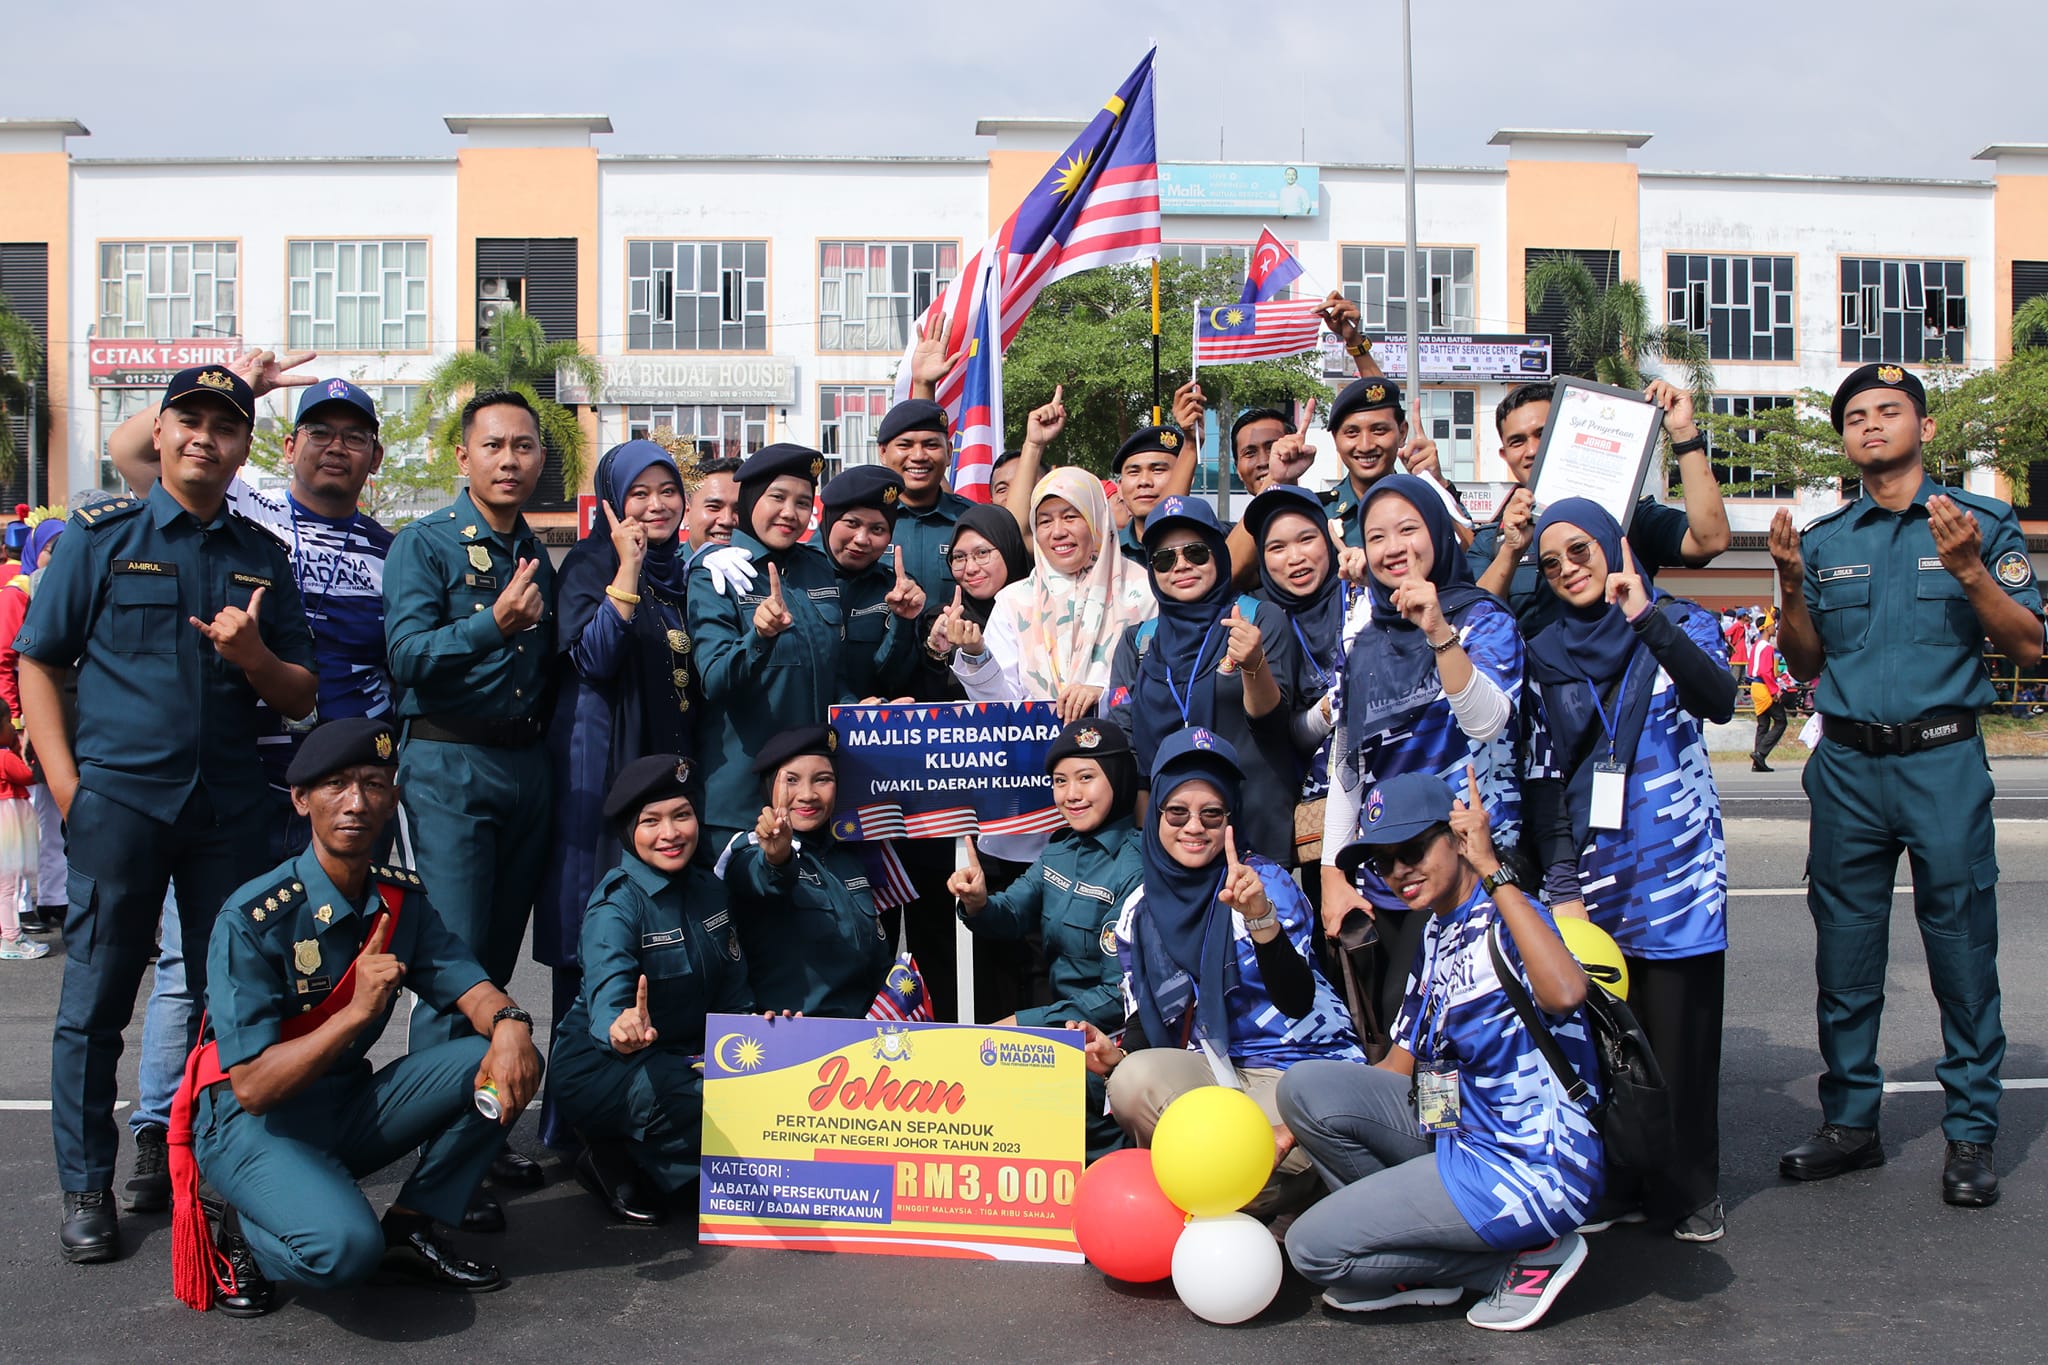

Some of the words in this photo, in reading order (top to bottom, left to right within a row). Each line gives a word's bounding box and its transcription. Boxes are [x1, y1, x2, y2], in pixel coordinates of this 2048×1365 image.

[1167, 183, 1206, 197] Malik
[1384, 335, 1407, 343] PUSAT
[91, 348, 155, 364] CETAK
[159, 348, 238, 364] T-SHIRT
[1384, 344, 1394, 354] SZ
[1430, 344, 1460, 354] BATTERY
[1462, 345, 1490, 355] SERVICE
[1491, 346, 1518, 355] CENTRE
[640, 363, 712, 387] BRIDAL
[718, 363, 786, 388] HOUSE
[1462, 491, 1491, 500] BATERI
[1469, 500, 1492, 510] CENTRE
[127, 561, 162, 572] AMIRUL
[848, 727, 922, 746] MAJLIS
[927, 725, 1061, 744] PERBANDARA
[925, 751, 1008, 769] KLUANG
[870, 778, 924, 794] (WAKIL
[927, 777, 988, 791] DAERAH
[1000, 1043, 1055, 1054] MALAYSIA
[1000, 1052, 1055, 1064] MADANI
[808, 1055, 966, 1115] Johan
[776, 1114, 901, 1132] PERTANDINGAN
[906, 1120, 994, 1137] SEPANDUK
[762, 1130, 836, 1144] PERINGKAT
[840, 1134, 889, 1147] NEGERI
[893, 1137, 938, 1149] JOHOR
[943, 1139, 989, 1151] TAHUN
[993, 1142, 1021, 1153] 2023
[711, 1161, 782, 1178] KATEGORI
[896, 1161, 1076, 1206] RM3,000
[710, 1182, 769, 1196] JABATAN
[773, 1184, 869, 1202] PERSEKUTUAN
[872, 1189, 880, 1204] /
[710, 1198, 755, 1212] NEGERI
[757, 1200, 764, 1214] /
[767, 1201, 810, 1216] BADAN
[813, 1204, 883, 1219] BERKANUN
[896, 1204, 929, 1212] RINGGIT
[932, 1205, 972, 1215] MALAYSIA
[980, 1208, 998, 1216] TIGA
[1001, 1209, 1020, 1217] RIBU
[1023, 1210, 1056, 1219] SAHAJA
